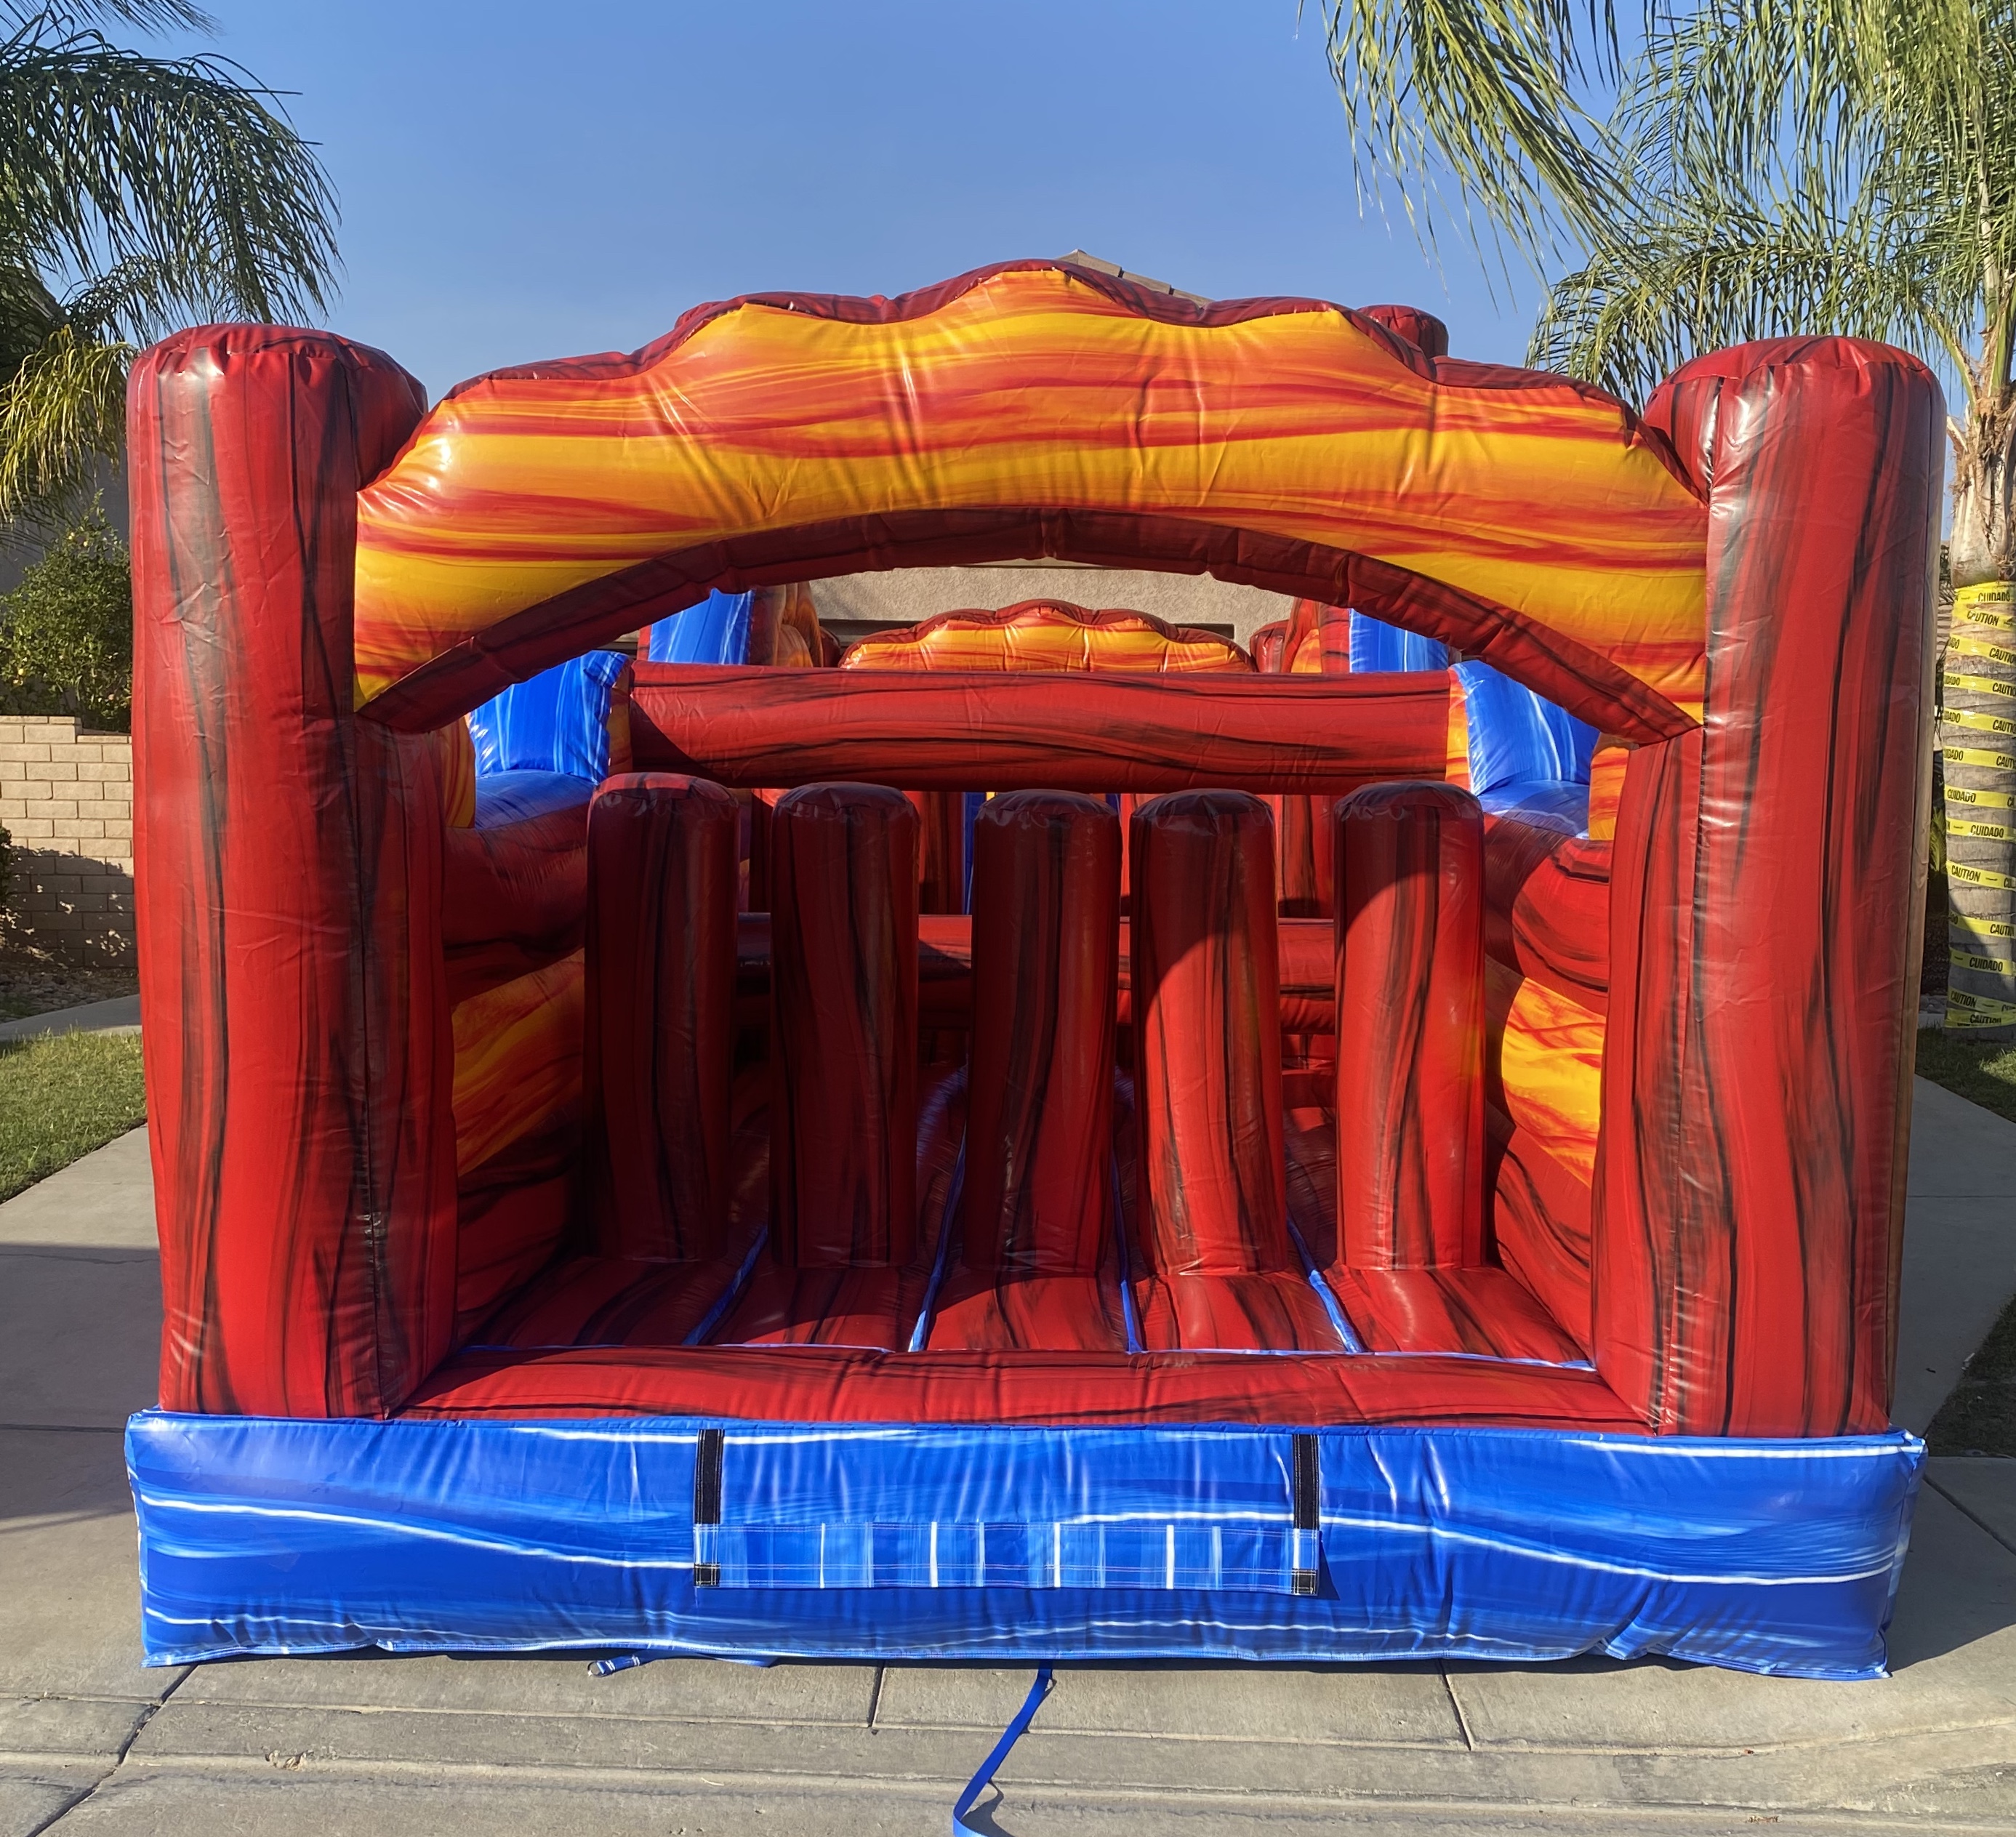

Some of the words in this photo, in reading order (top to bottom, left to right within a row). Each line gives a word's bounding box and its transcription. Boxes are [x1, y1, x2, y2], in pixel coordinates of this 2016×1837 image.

[1967, 611, 1999, 626] CAUTION
[1947, 789, 1977, 803] CUIDADO
[1970, 825, 2004, 838] CUIDADO
[1951, 865, 1981, 882] CAUTION
[1969, 957, 2004, 972] CUIDADO
